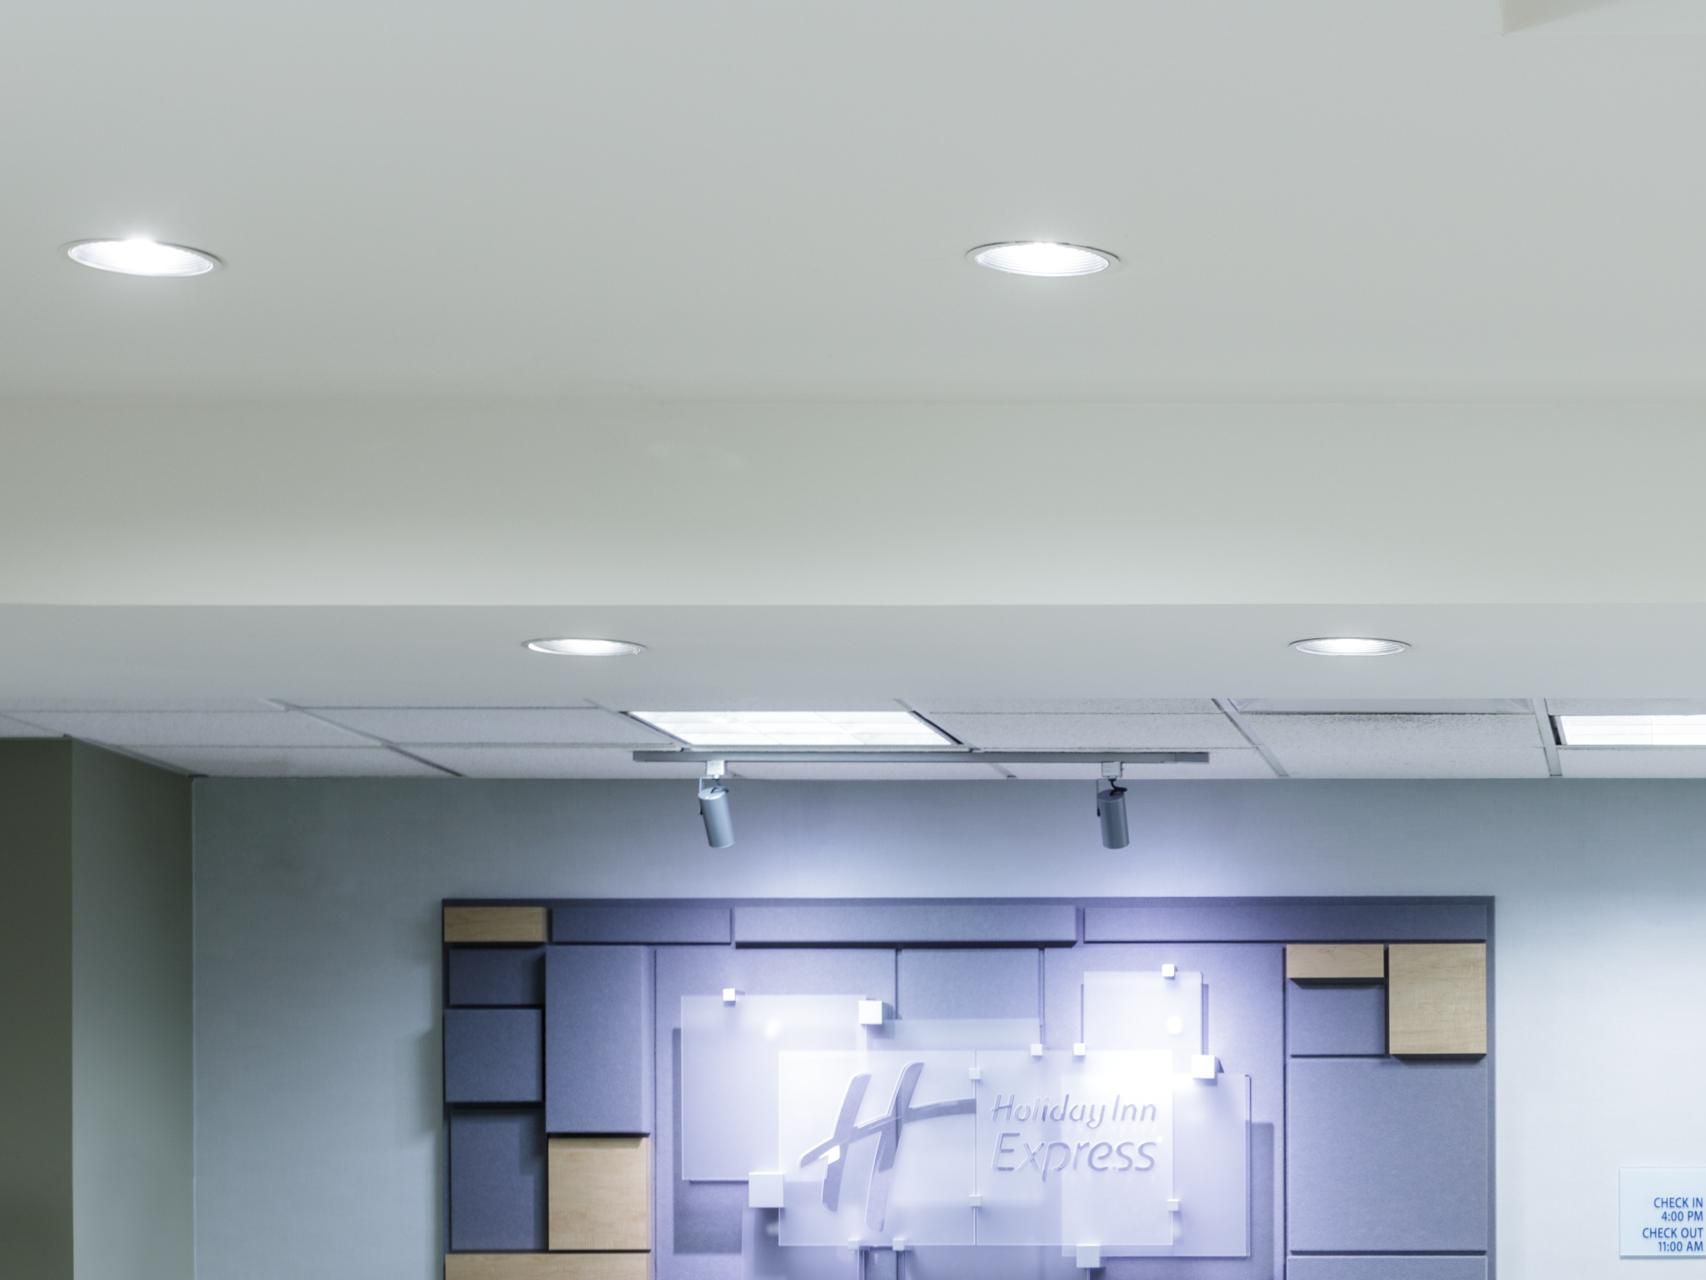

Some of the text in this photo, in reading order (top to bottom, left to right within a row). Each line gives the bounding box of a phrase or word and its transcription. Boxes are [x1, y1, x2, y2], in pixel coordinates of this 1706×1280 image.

[992, 1093, 1157, 1129] Holiday Inn
[992, 1132, 1157, 1182] Express
[1653, 1196, 1704, 1209] CHECK IN
[1661, 1210, 1704, 1222] 4:00 PM
[1642, 1227, 1704, 1239] CHECK OUT
[1658, 1240, 1704, 1252] 11:00 AM
